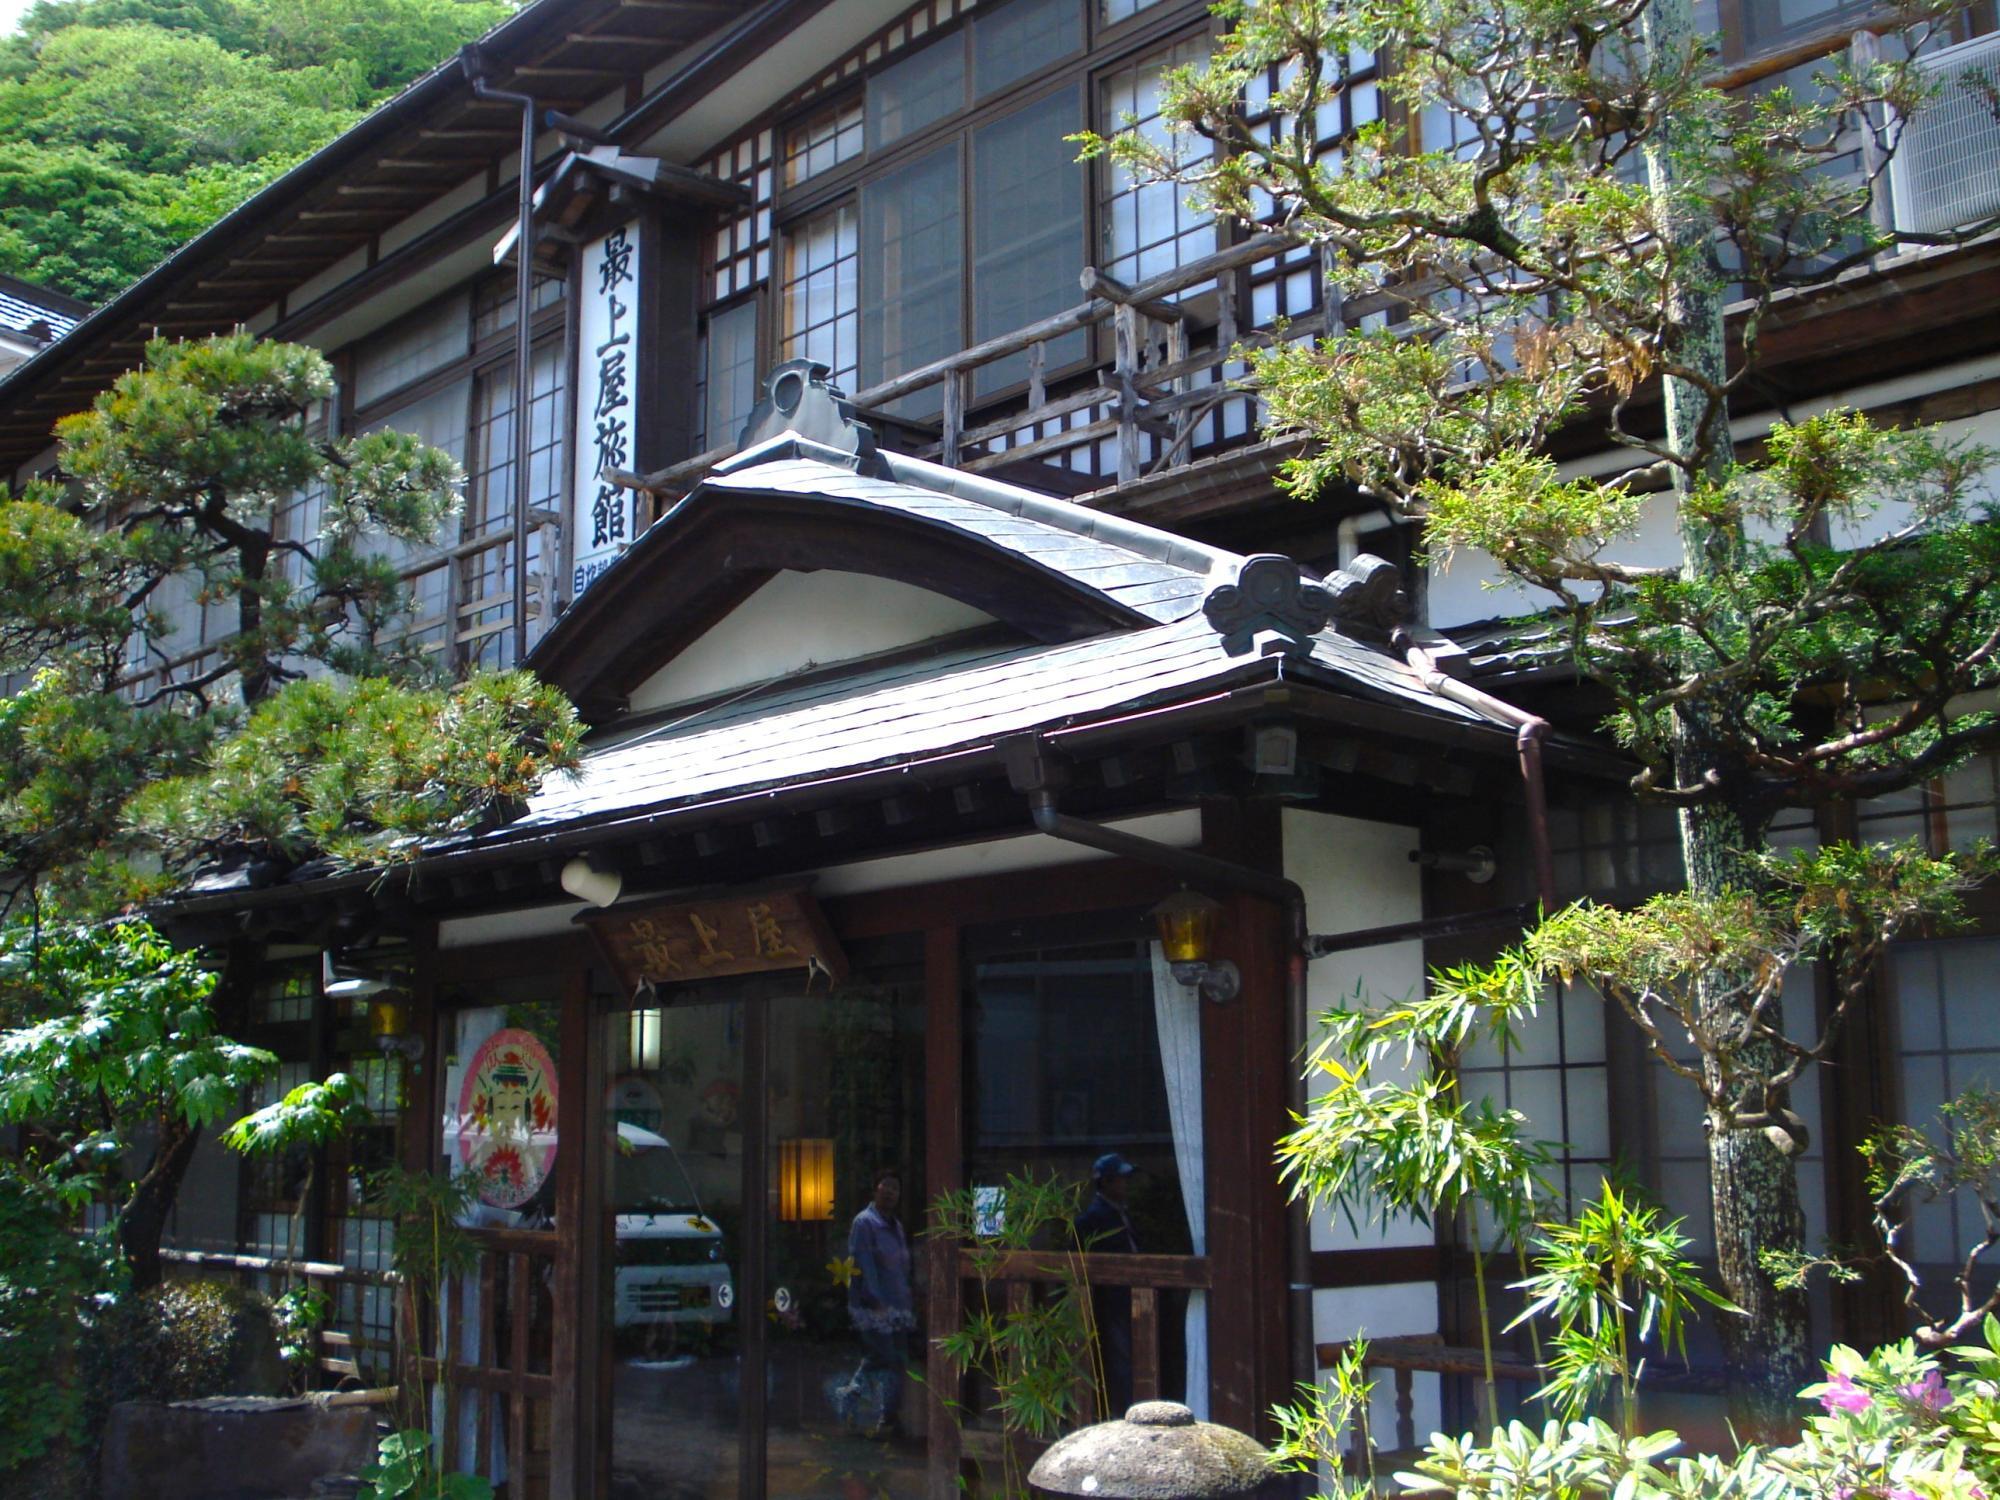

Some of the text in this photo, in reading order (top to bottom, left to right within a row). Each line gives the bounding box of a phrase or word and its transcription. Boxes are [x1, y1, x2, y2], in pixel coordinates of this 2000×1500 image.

[592, 227, 634, 548] 最上屋旅館
[630, 902, 800, 975] 最上屋
